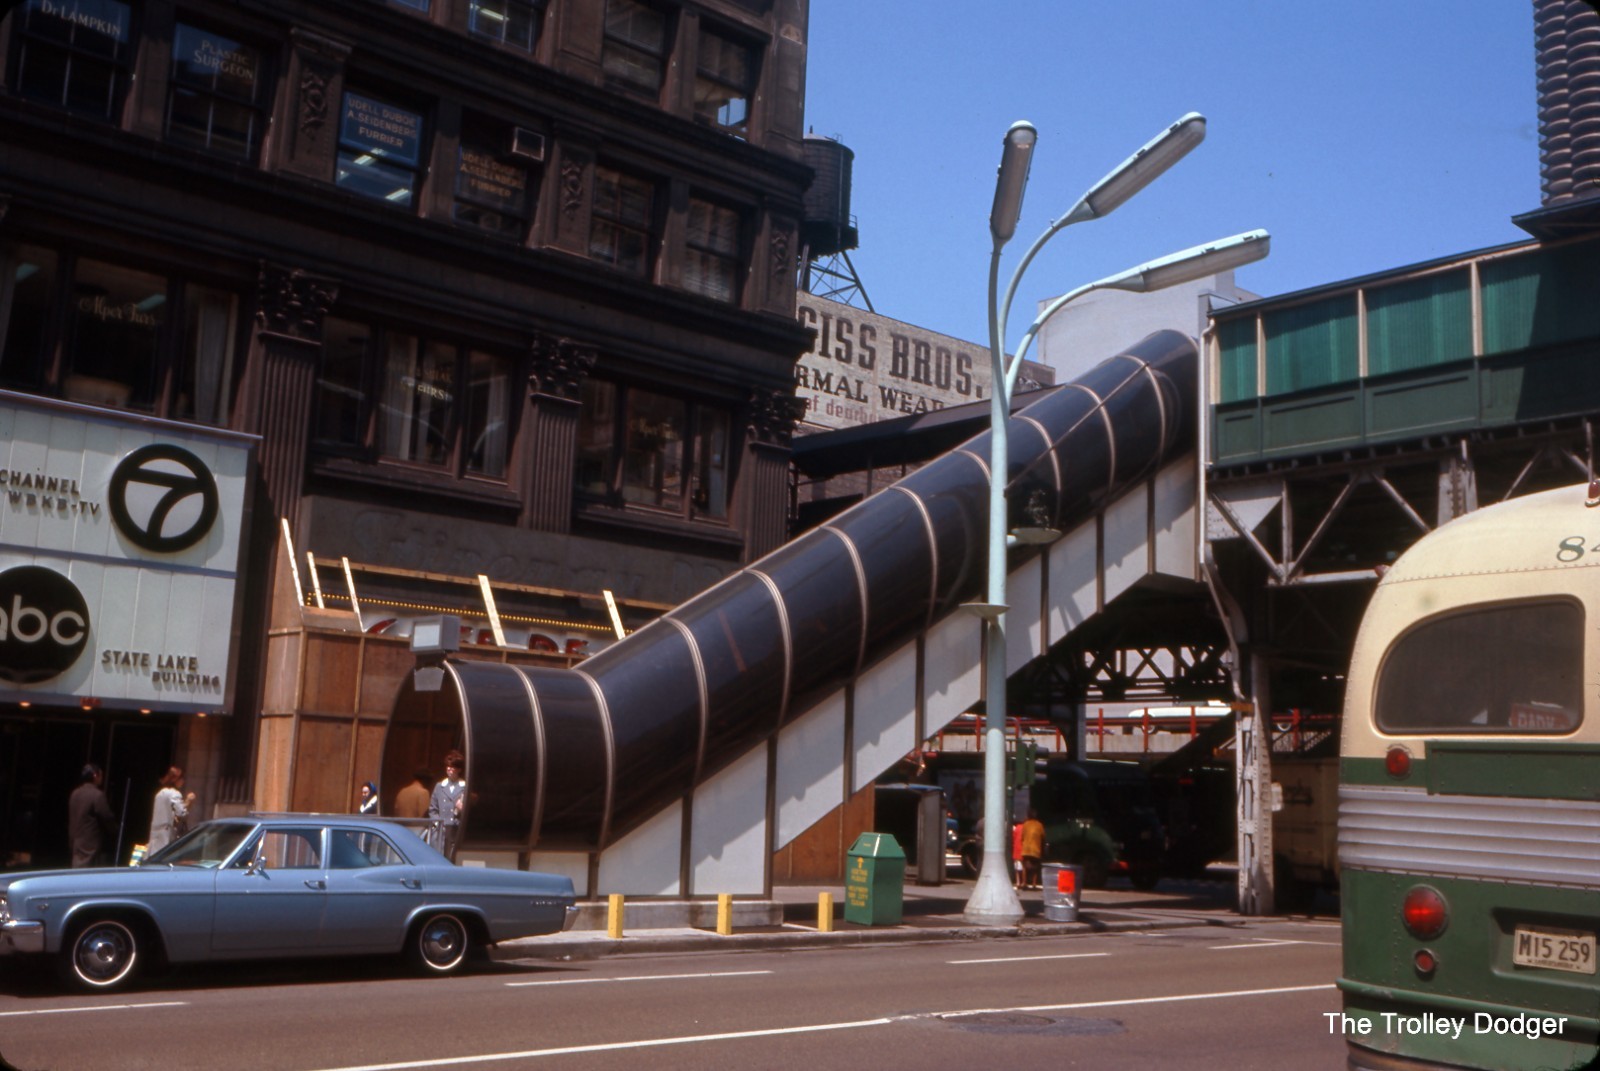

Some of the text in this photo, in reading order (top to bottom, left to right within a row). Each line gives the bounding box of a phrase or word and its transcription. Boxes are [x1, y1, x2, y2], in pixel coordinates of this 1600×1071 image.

[60, 5, 120, 36] LAMPKIN
[193, 50, 253, 79] SURGEON
[201, 39, 250, 65] PLASTIC
[359, 126, 404, 147] FURRIER
[888, 332, 983, 399] BROS.
[0, 469, 80, 496] CHANNEL
[8, 490, 100, 515] WBKB-TV
[101, 649, 198, 671] STATE LAKE
[152, 671, 222, 688] BUILDING
[1558, 940, 1590, 964] 259
